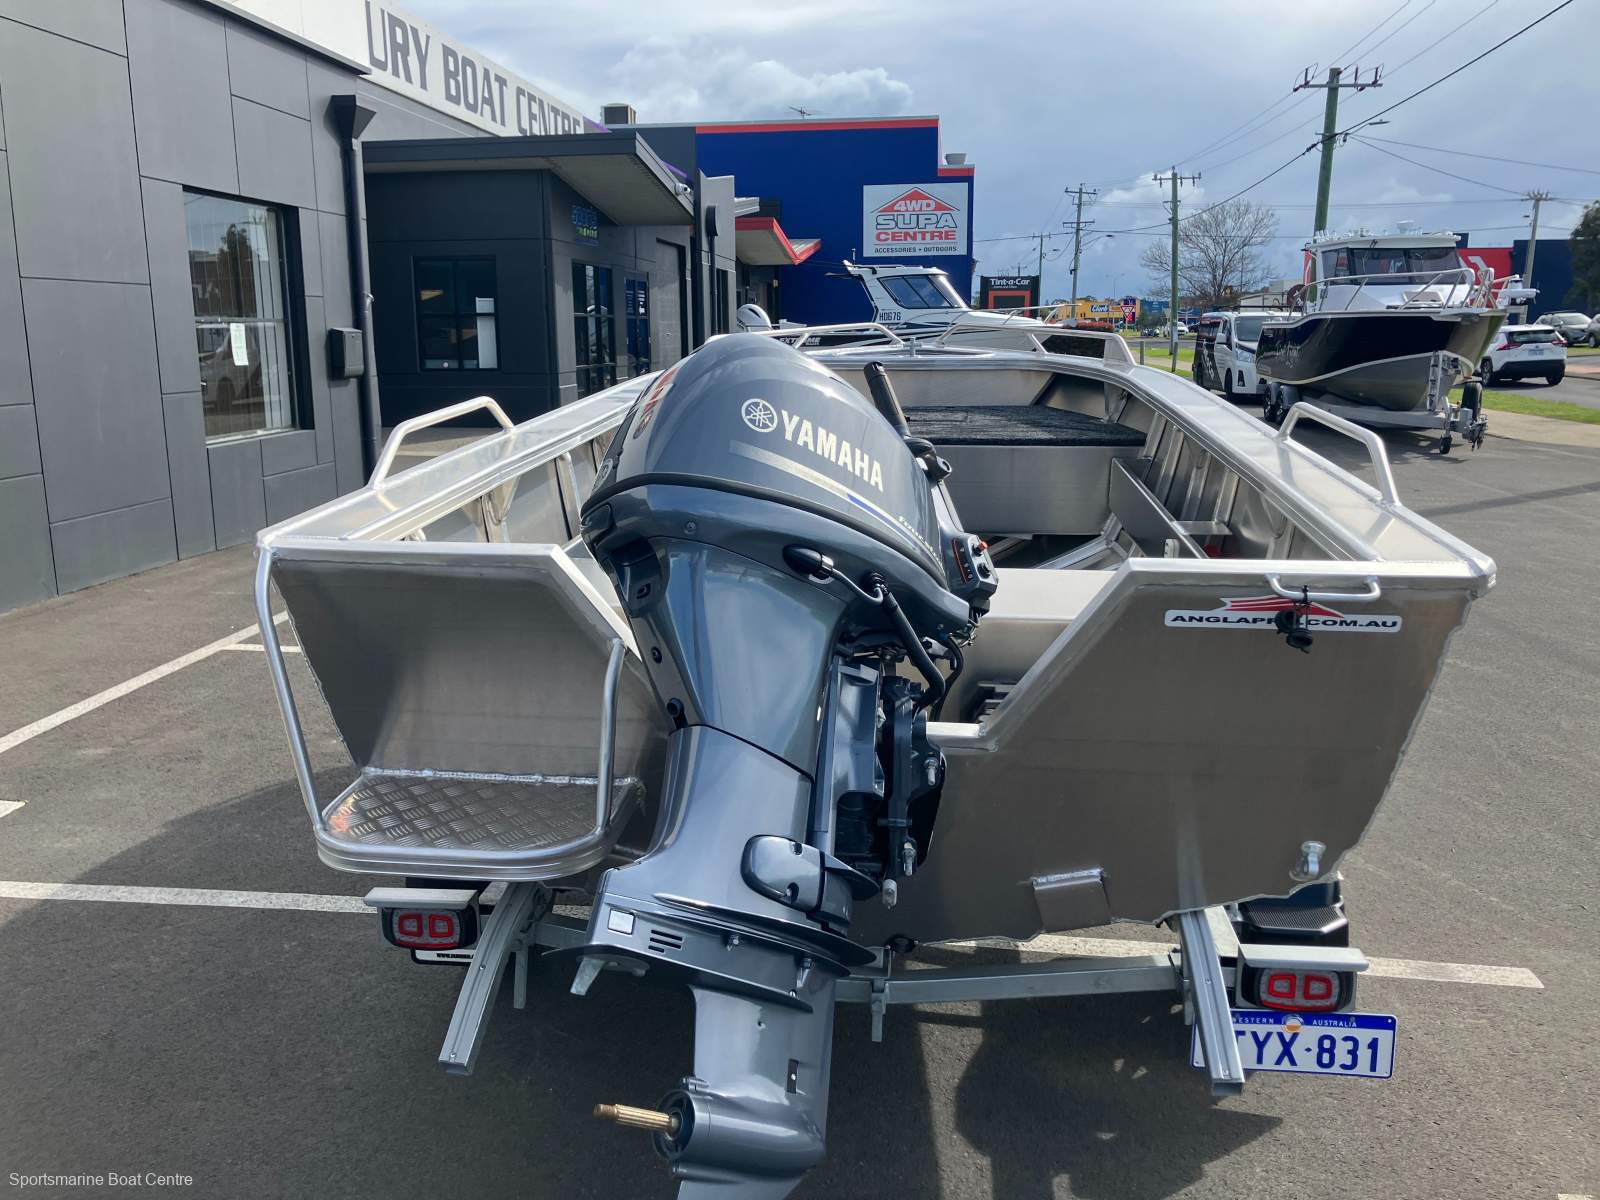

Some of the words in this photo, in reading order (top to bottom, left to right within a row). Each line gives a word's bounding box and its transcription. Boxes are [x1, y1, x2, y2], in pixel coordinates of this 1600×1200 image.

[442, 43, 507, 127] BOAT
[894, 199, 936, 212] 4WD
[875, 212, 958, 230] SUPA
[875, 230, 957, 242] CENTRE
[874, 245, 917, 254] ACCESSORIES
[923, 245, 958, 253] OUTDOORS
[781, 409, 884, 492] YAMAHA
[1172, 615, 1398, 628] ANGLAP.COM.AU
[1312, 1019, 1357, 1028] AUSTRALIA
